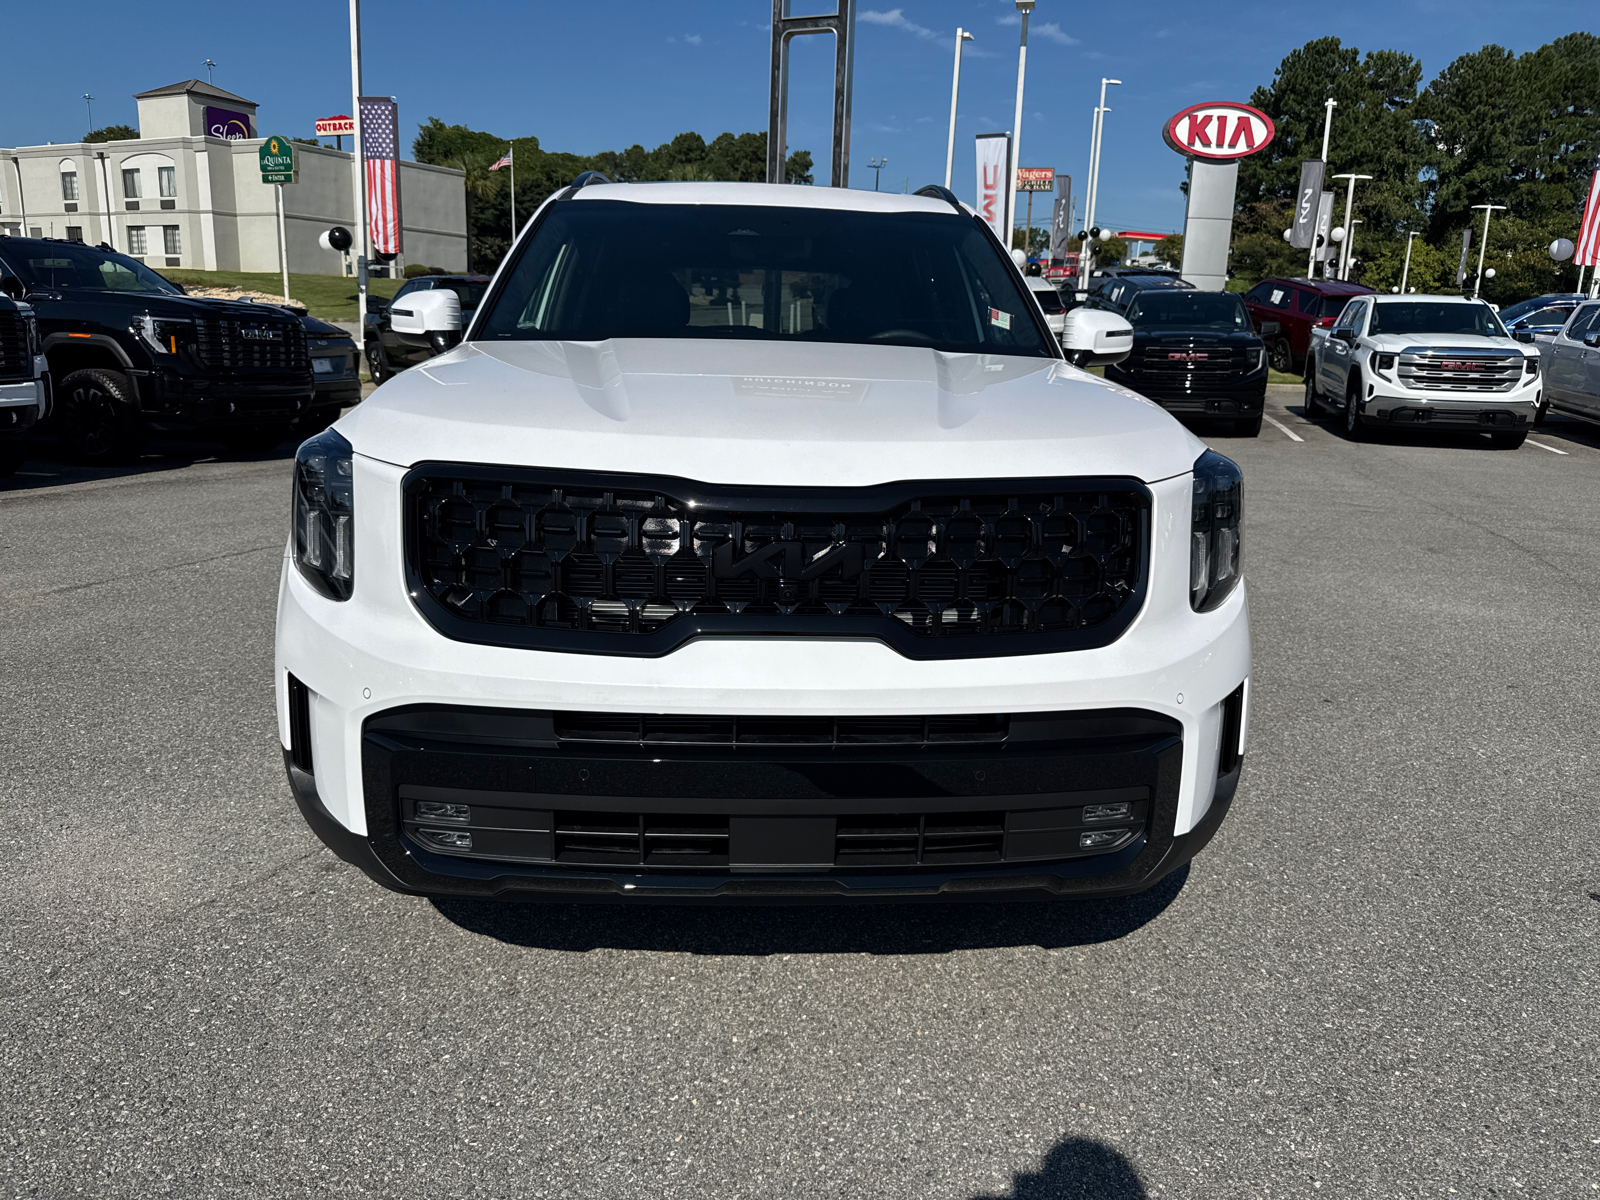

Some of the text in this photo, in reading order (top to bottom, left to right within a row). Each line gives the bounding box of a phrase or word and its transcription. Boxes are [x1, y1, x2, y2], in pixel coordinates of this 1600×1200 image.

[316, 122, 354, 132] OUTBACK
[1187, 114, 1255, 149] KIA
[983, 163, 998, 223] MC
[1168, 353, 1208, 361] GMC
[1441, 361, 1486, 371] GMC
